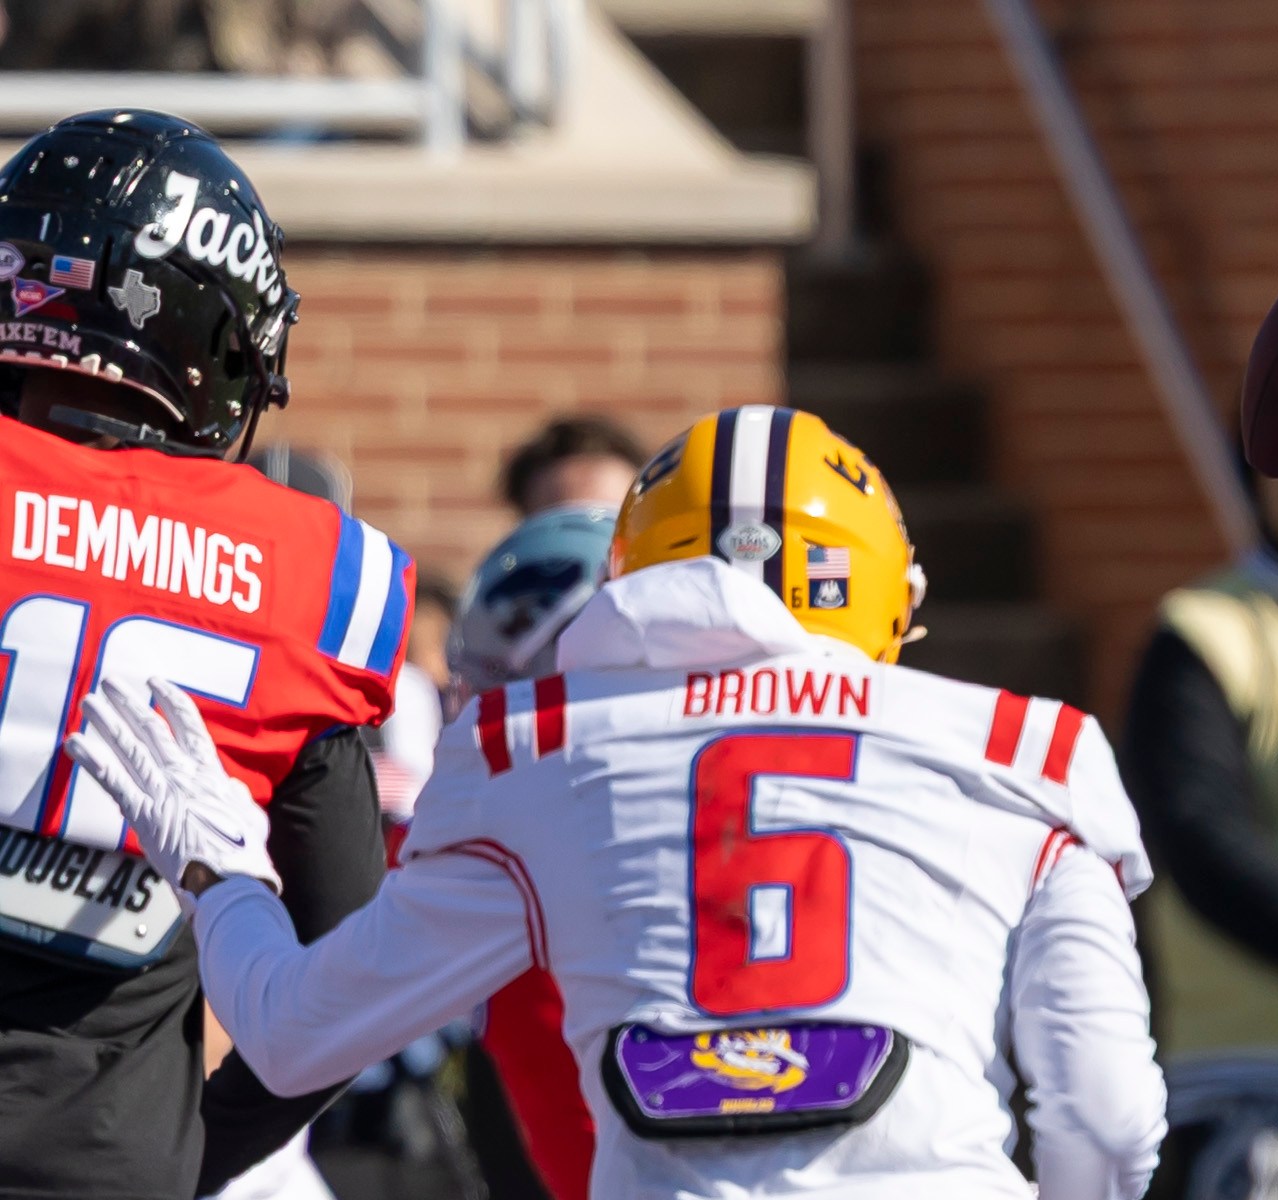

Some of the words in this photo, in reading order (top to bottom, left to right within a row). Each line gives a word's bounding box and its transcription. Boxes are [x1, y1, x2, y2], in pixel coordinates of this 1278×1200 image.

[11, 490, 264, 614] DEMMINGS
[682, 667, 872, 719] BROWN
[0, 828, 163, 914] OUGLAS
[686, 726, 864, 1020] 6
